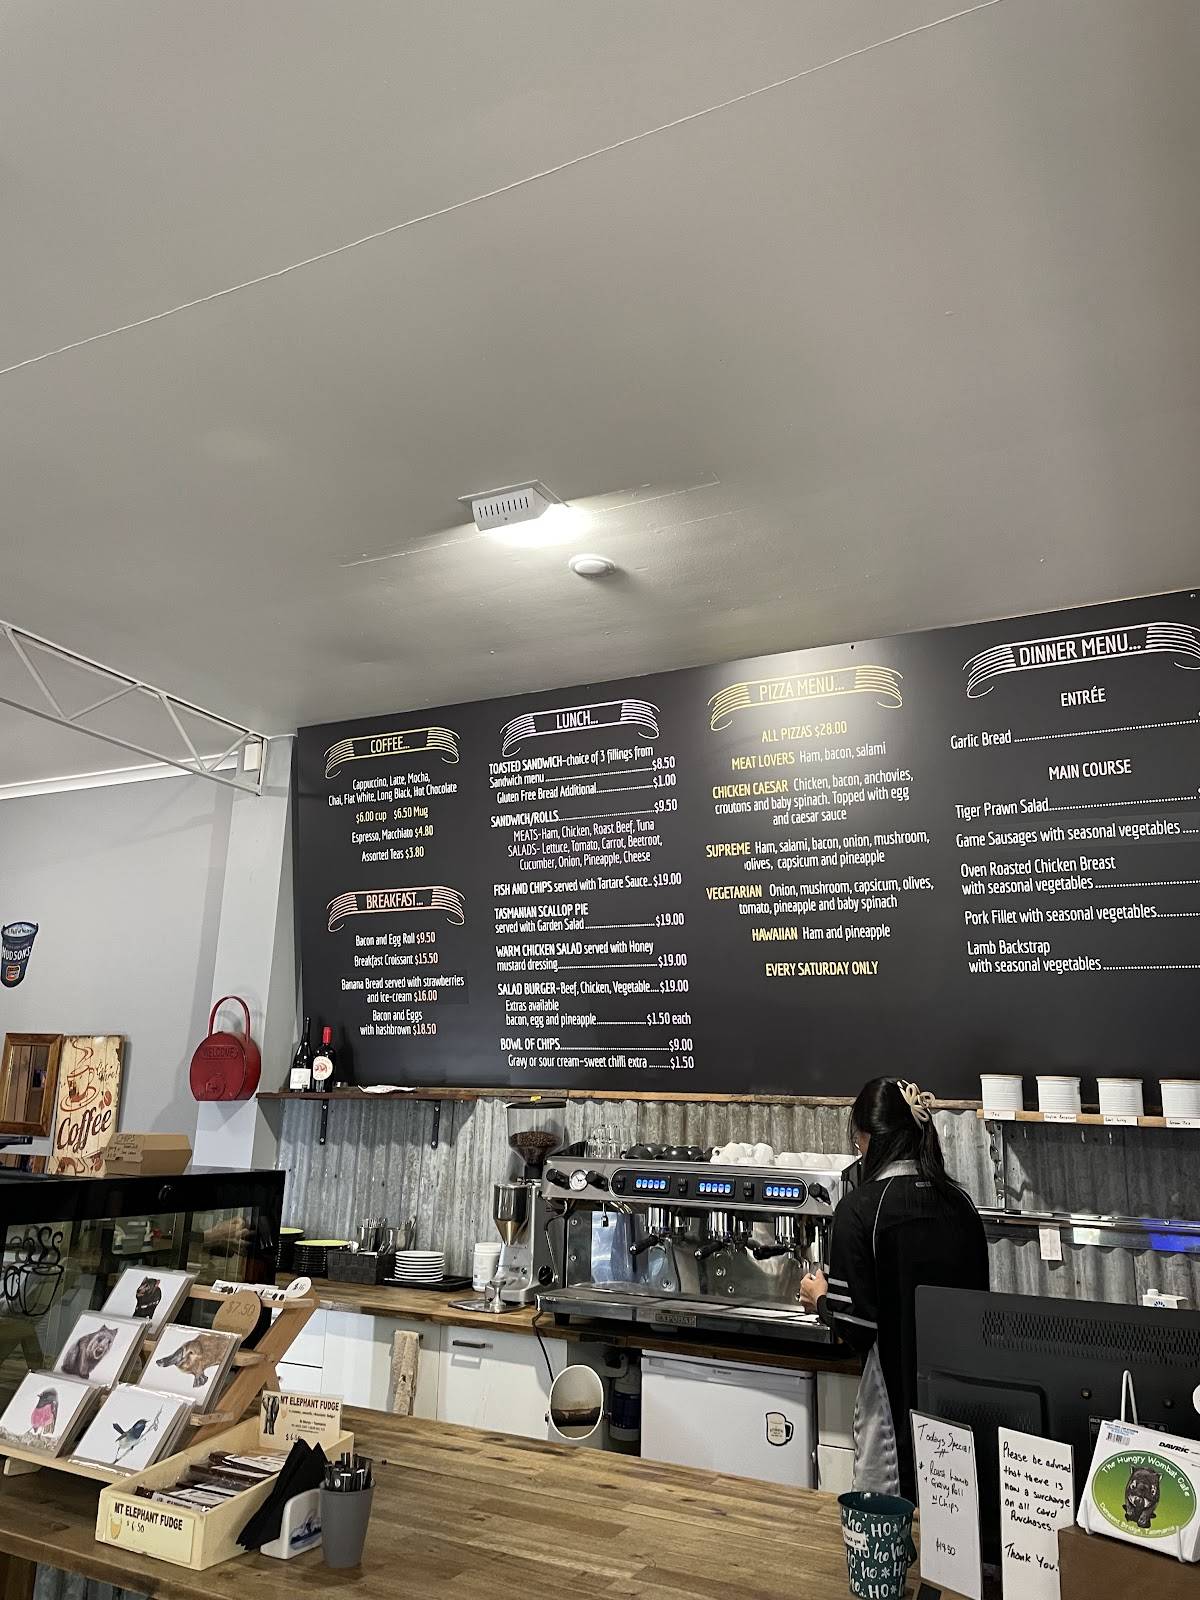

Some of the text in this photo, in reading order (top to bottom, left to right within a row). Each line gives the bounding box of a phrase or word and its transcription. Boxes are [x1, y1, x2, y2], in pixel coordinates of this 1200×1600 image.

[1019, 633, 1141, 666] DINNER MENU...
[759, 683, 794, 700] PIZZA
[1061, 685, 1106, 707] ENTRÉE
[556, 710, 599, 729] LUNCH...
[762, 721, 847, 743] ALL PIZZAS $28.00
[951, 730, 1012, 750] Garlic Bread
[731, 742, 886, 770] MEAT LOVERS Ham, bacon, salami
[1049, 759, 1132, 781] MAIN COURSE
[353, 772, 430, 791] Cappuccino, Latte, Mocha,
[712, 769, 913, 799] CHICKEN CAESAR Chicken, bacon, anchovies,
[356, 806, 428, 824] $6.00 cup $6.50 Mug
[955, 803, 981, 821] Tiger
[984, 801, 1018, 817] Prawn
[352, 825, 433, 844] Espresso, Macchiato $4.80
[514, 819, 655, 842] MEATS-Ham, Chicken, Roast Beef, Tuna
[956, 820, 1181, 848] Game Sausages with seasonal vegetables
[361, 846, 424, 862] Assorted Teas $3.80
[706, 830, 930, 858] SUPREME Ham, salami, bacon, onion, mushroom,
[520, 850, 651, 870] Cucumber, Onion, Pineapple, Cheese
[961, 856, 1116, 878] Oven Roasted Chicken Breast
[494, 903, 588, 920] TASMANIAN SCALLOP PIE
[495, 913, 684, 933] served with Garden Salad $19.00
[752, 924, 891, 942] HAWAIIAN Ham and pineapple
[355, 932, 435, 947] Bacon and Egg Roll $9.50
[496, 941, 653, 957] WARM CHICKEN SALAD served with Honey
[968, 939, 1050, 956] Lamb Backstrap
[354, 952, 438, 968] Breakfast Croissant $15.50
[766, 961, 879, 977] EVERY SATURDAY ONLY
[506, 999, 559, 1011] Extras available
[57, 1107, 112, 1153] Coffee
[290, 1397, 318, 1408] ELEPHANT
[320, 1400, 339, 1411] FUDGE
[1003, 1441, 1071, 1473] Please be advised
[1159, 1442, 1189, 1453] DAVRIC
[1004, 1466, 1021, 1477] that
[1024, 1472, 1049, 1486] there
[1102, 1462, 1116, 1474] The
[1118, 1456, 1146, 1464] Hungry
[1148, 1456, 1178, 1478] Wombat
[1005, 1483, 1070, 1509] now a surcharge
[114, 1502, 183, 1531] MT ELEPHANT FUDGE
[1005, 1499, 1057, 1518] on all card
[871, 1522, 891, 1537] HO
[1005, 1542, 1031, 1562] Thank
[869, 1584, 889, 1599] HO
